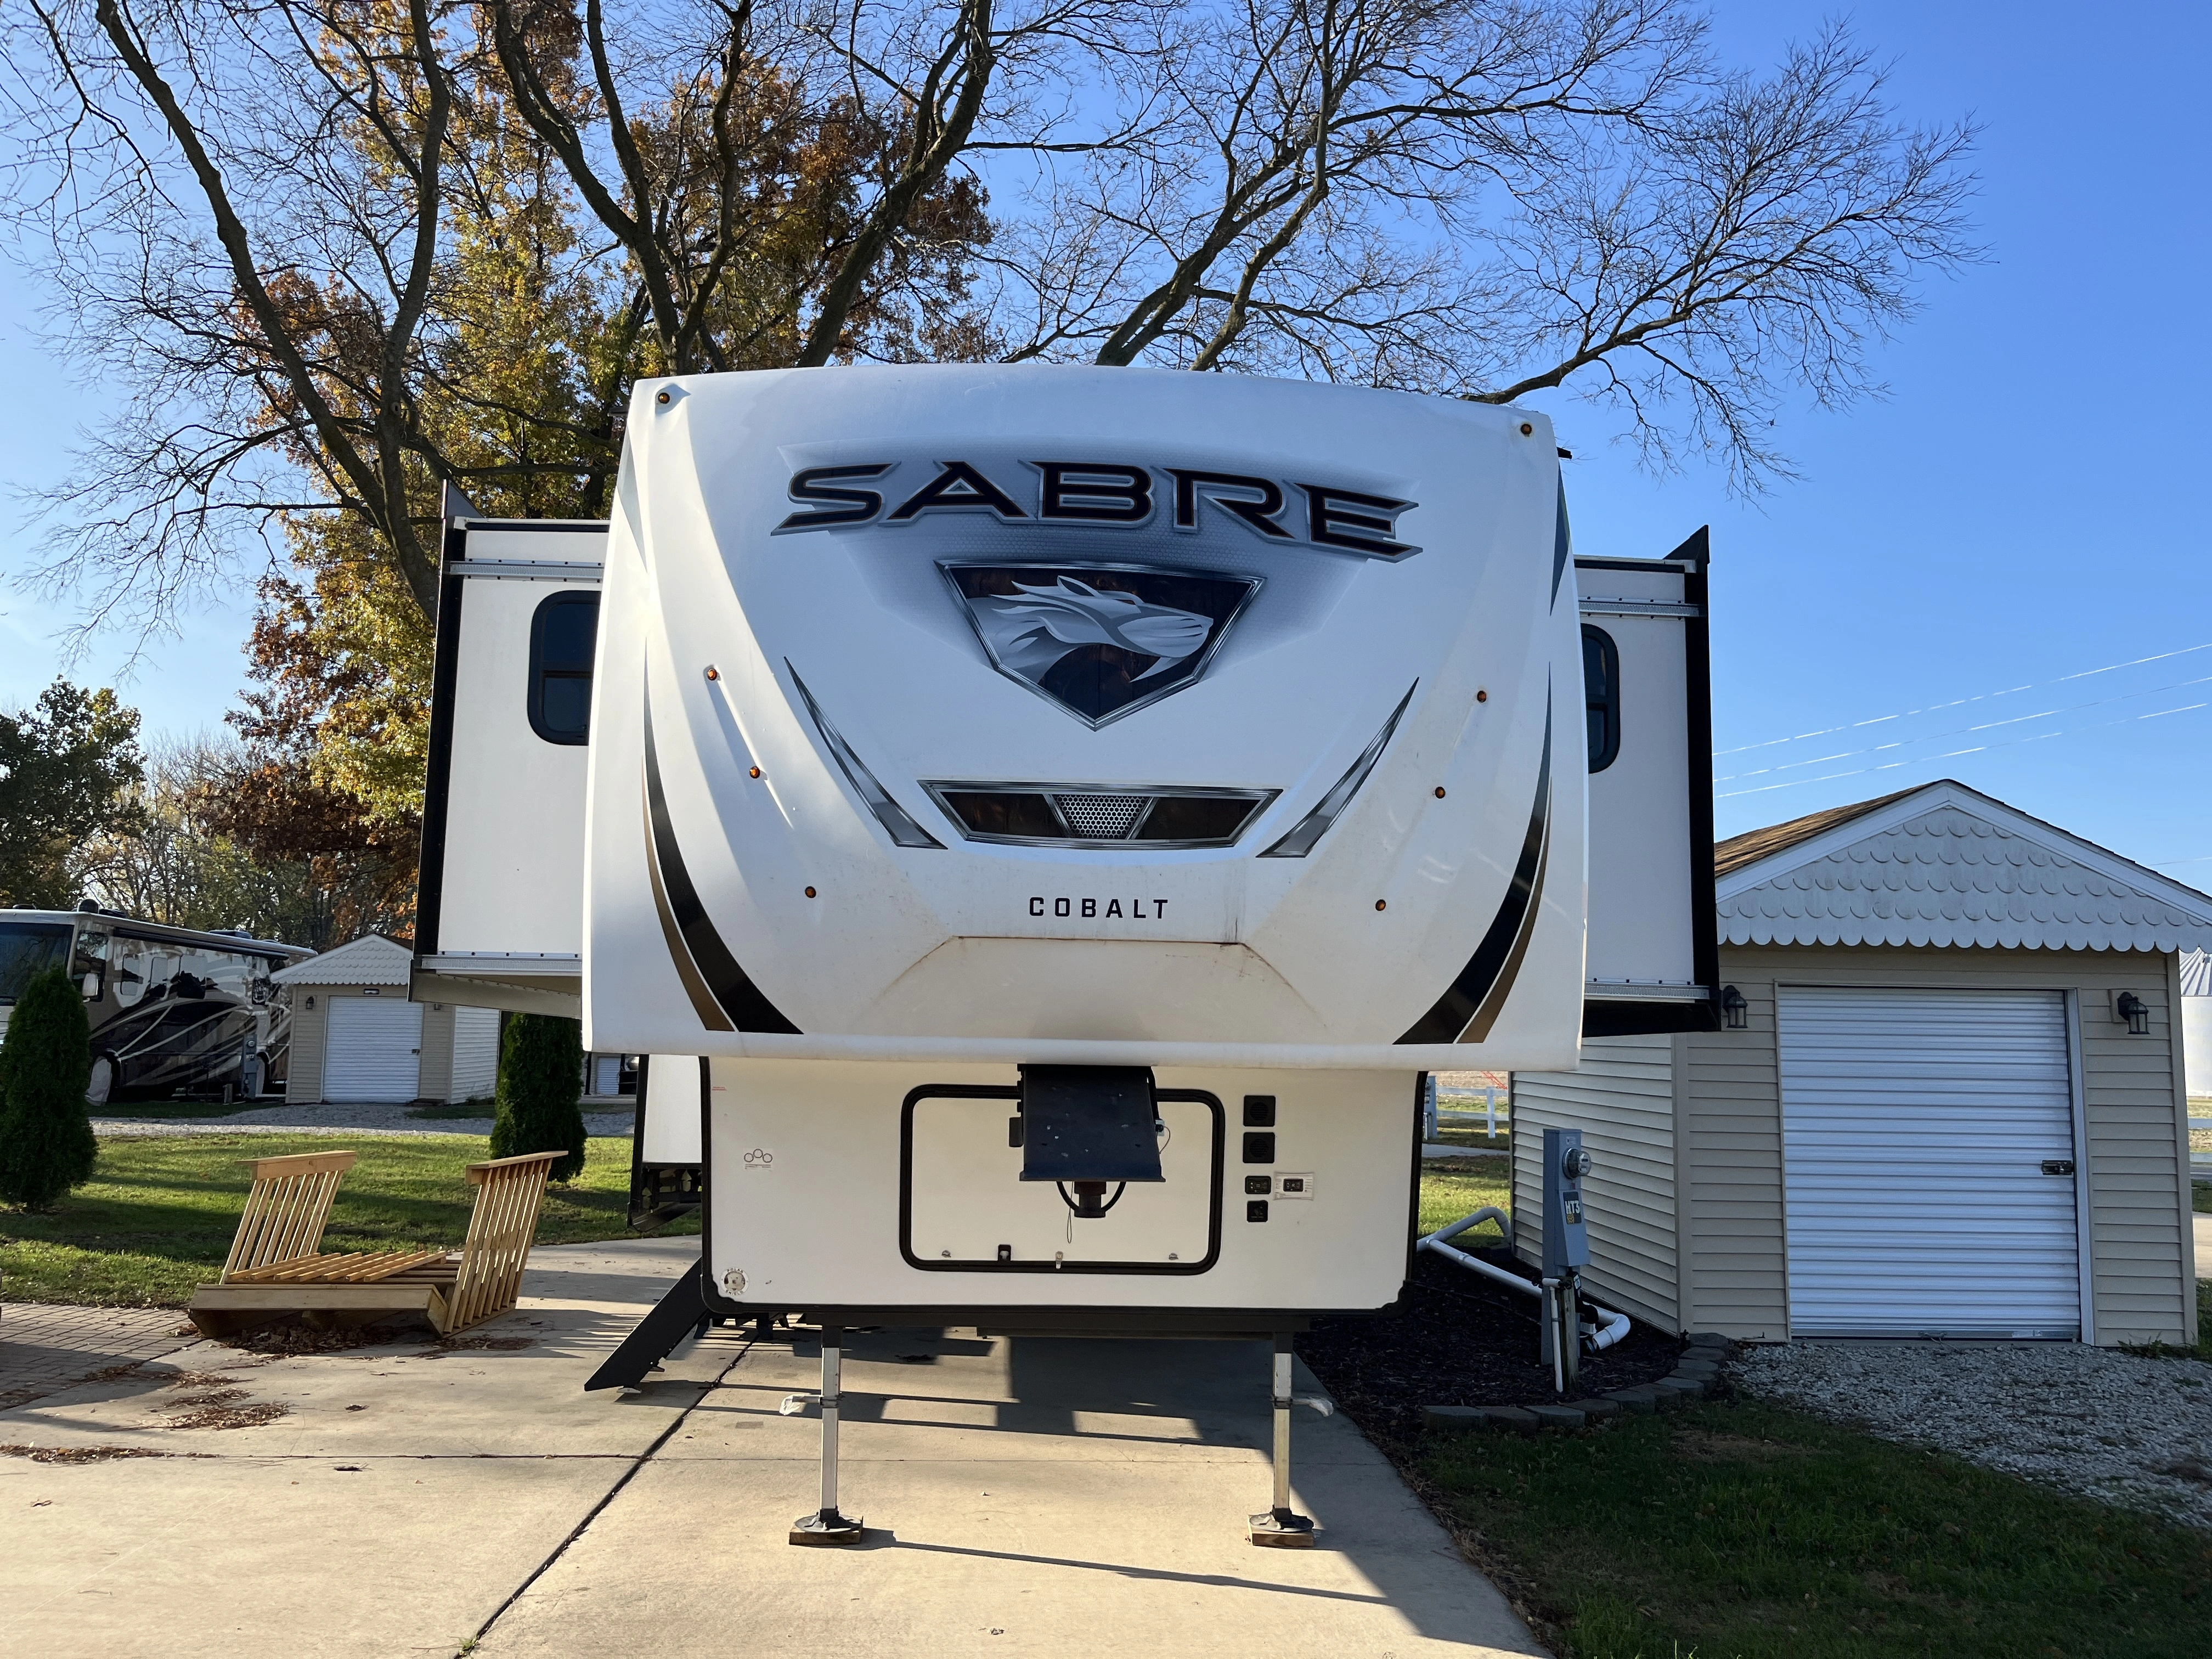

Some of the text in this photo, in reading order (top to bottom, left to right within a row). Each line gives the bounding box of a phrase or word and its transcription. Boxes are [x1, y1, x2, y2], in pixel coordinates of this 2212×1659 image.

[771, 460, 1424, 563] SABRE
[1029, 896, 1168, 919] COBALT
[1565, 1200, 1580, 1214] HT3
